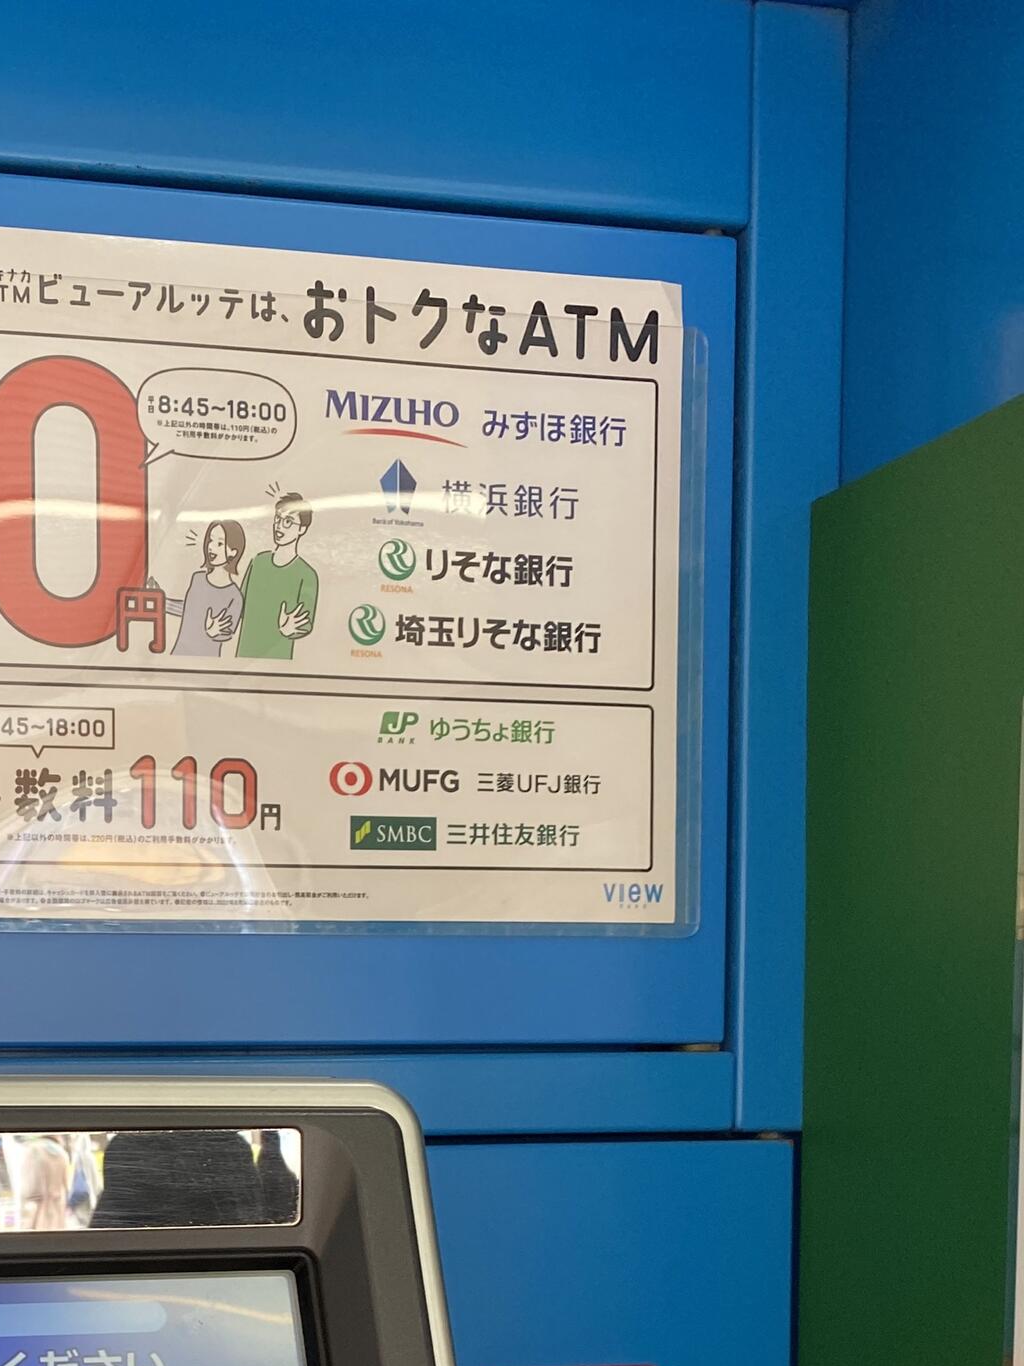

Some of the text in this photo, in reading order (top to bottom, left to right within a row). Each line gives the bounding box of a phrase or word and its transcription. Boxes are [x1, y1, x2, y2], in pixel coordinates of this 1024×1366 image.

[39, 274, 289, 323] ビューアルッテは、
[303, 280, 659, 364] おトクなATM
[325, 389, 626, 448] MIZUHO みずほ銀行
[442, 480, 579, 520] 横浜銀行
[426, 549, 573, 588] りそな銀行
[381, 584, 413, 594] RESONA
[395, 614, 601, 653] 埼玉りそな銀行
[430, 716, 555, 744] ゆうちょ銀行
[379, 768, 601, 795] MUFG 三菱UFJ銀行
[376, 823, 580, 847] SMBC 三井住友銀行
